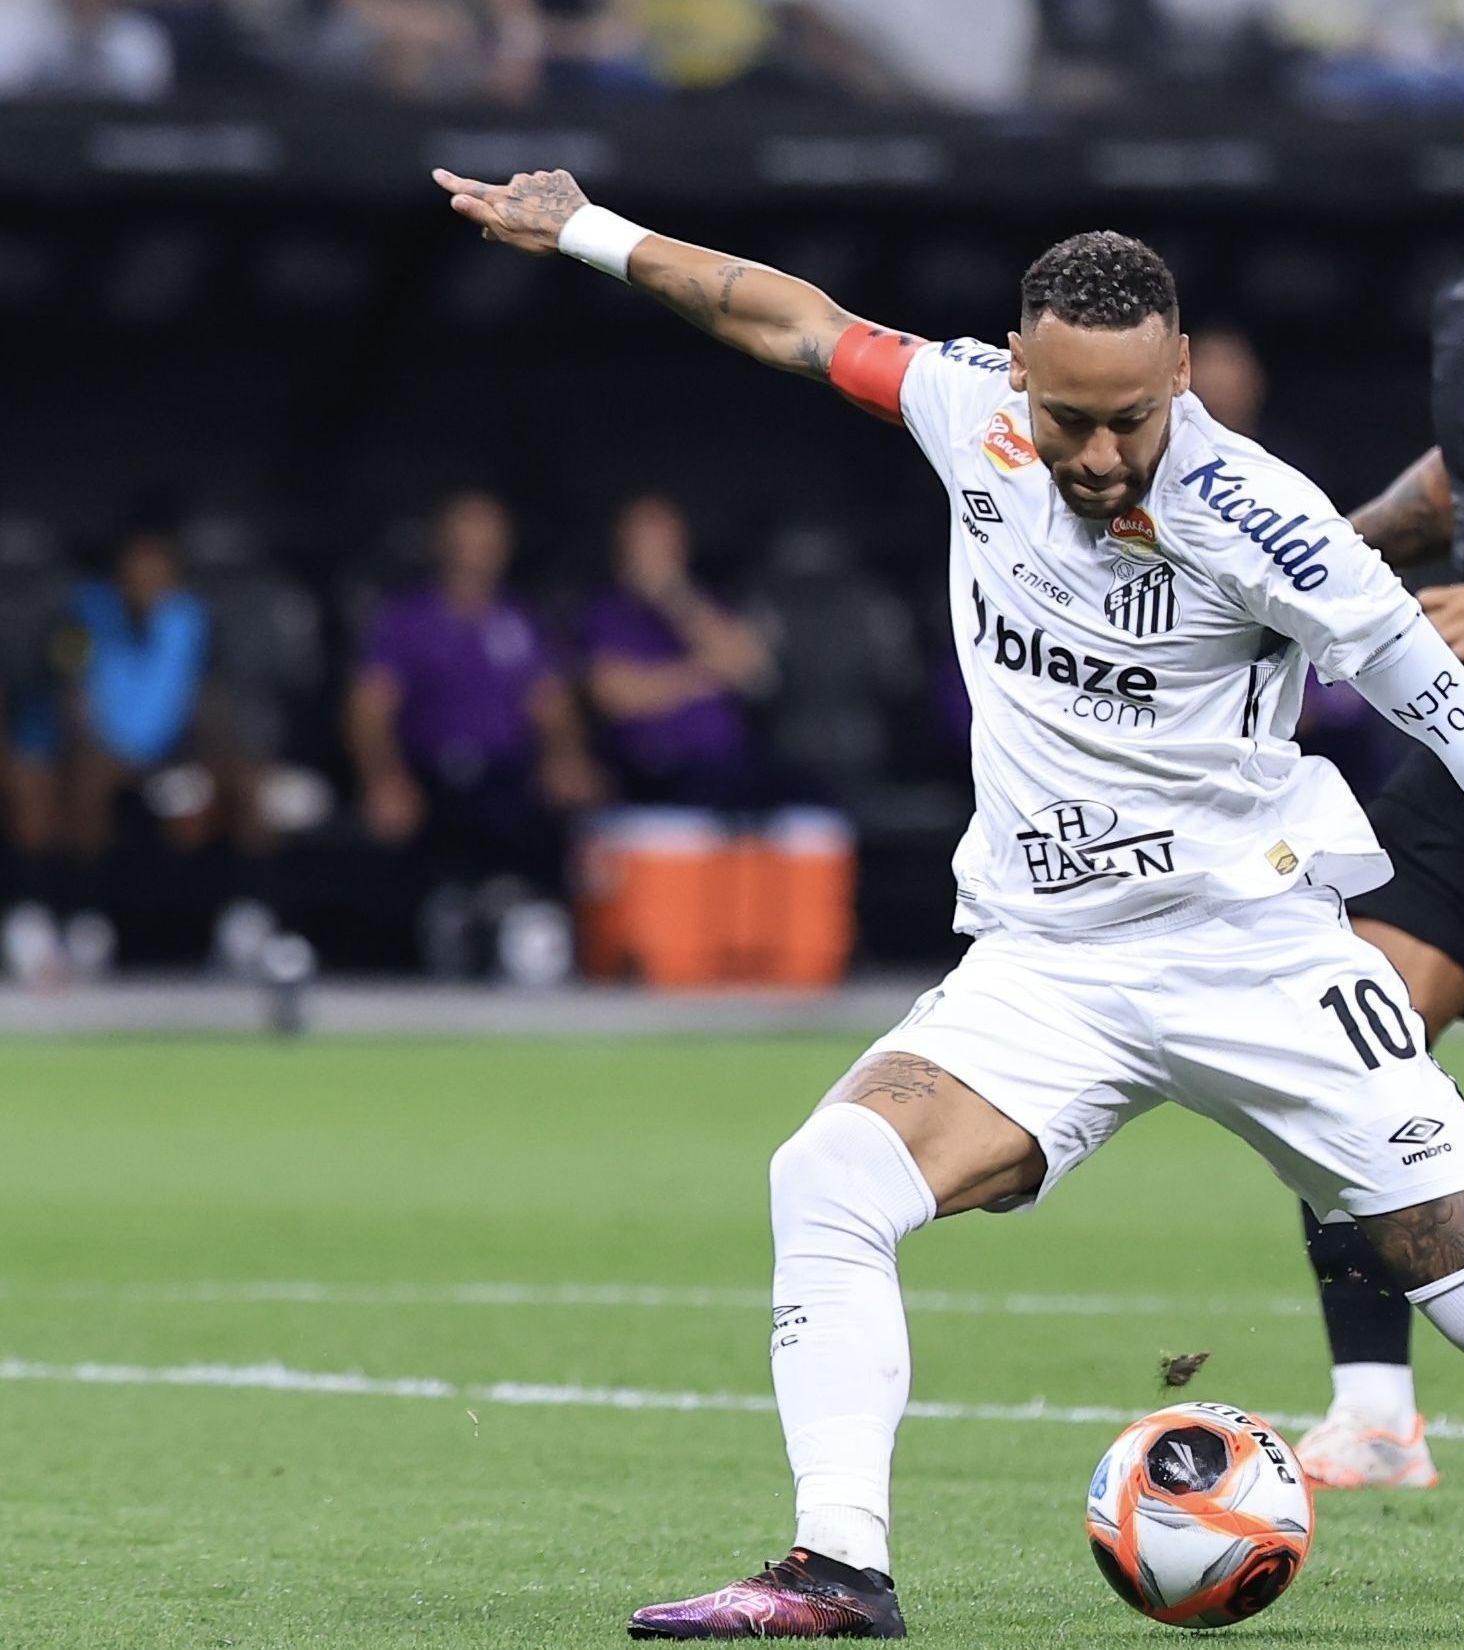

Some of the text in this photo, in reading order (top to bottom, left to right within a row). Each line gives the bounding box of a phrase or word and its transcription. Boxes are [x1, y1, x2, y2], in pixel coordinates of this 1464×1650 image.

[1180, 456, 1330, 592] Kicaldo
[995, 615, 1158, 702] blaze
[1391, 669, 1460, 726] NJR
[1053, 806, 1092, 842] H
[1021, 841, 1175, 884] HAN
[1319, 978, 1417, 1070] 10
[1402, 1141, 1452, 1167] umbro
